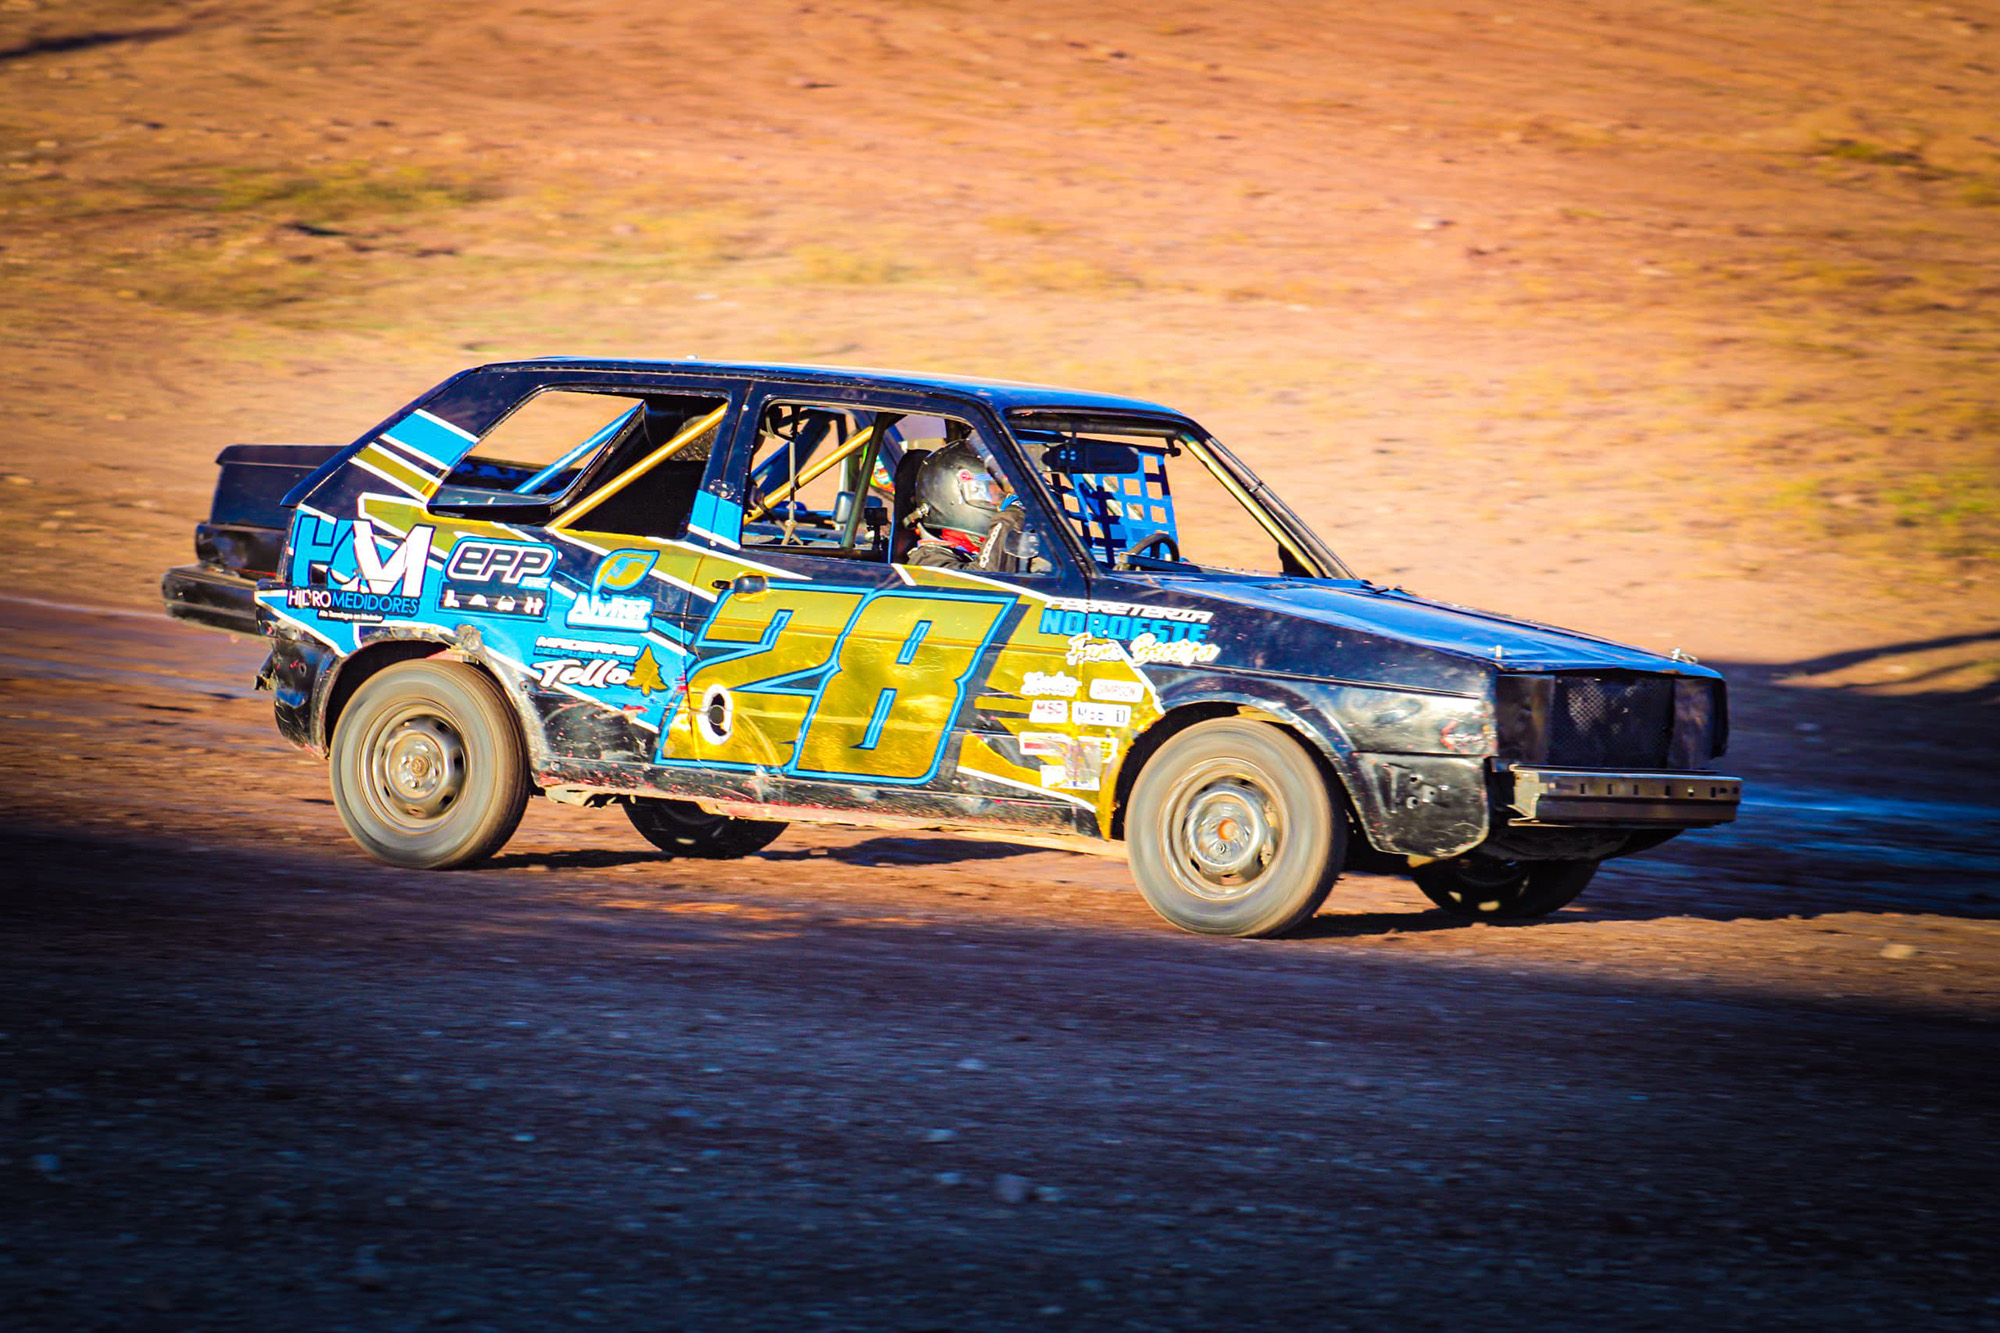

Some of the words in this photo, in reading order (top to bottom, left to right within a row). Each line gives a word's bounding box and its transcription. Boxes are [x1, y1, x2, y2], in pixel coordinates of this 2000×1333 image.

[1039, 608, 1210, 643] NOROESTE
[1045, 596, 1213, 623] FERRETERIA
[532, 658, 634, 688] Tello
[656, 581, 1018, 784] 28
